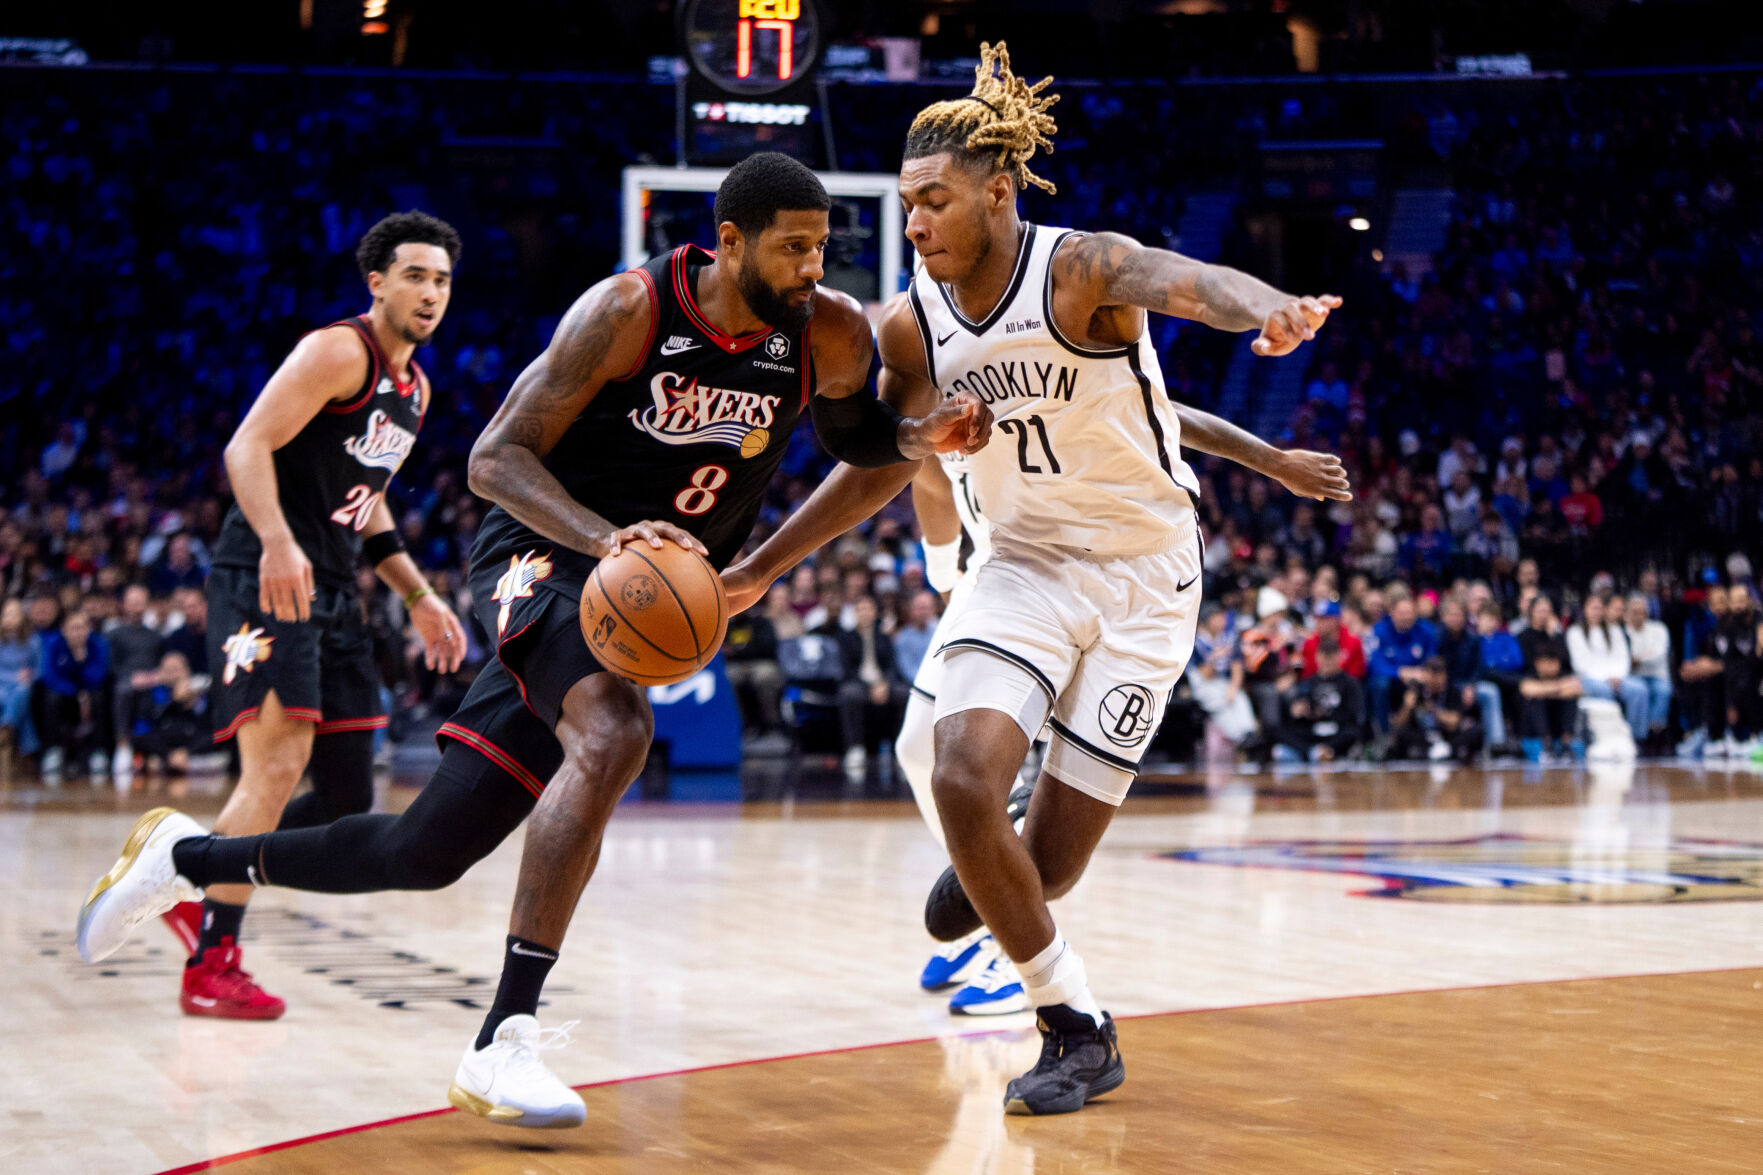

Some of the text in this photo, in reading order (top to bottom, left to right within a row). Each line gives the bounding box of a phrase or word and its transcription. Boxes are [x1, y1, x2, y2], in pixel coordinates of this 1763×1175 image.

[737, 18, 794, 80] 17
[666, 335, 693, 350] NIKE
[1006, 318, 1041, 334] All In Won
[752, 360, 795, 374] crypto.com
[946, 361, 1079, 406] OOKLYN
[998, 414, 1062, 474] 21
[330, 484, 382, 532] 20
[673, 463, 730, 517] 8
[1113, 693, 1145, 737] B
